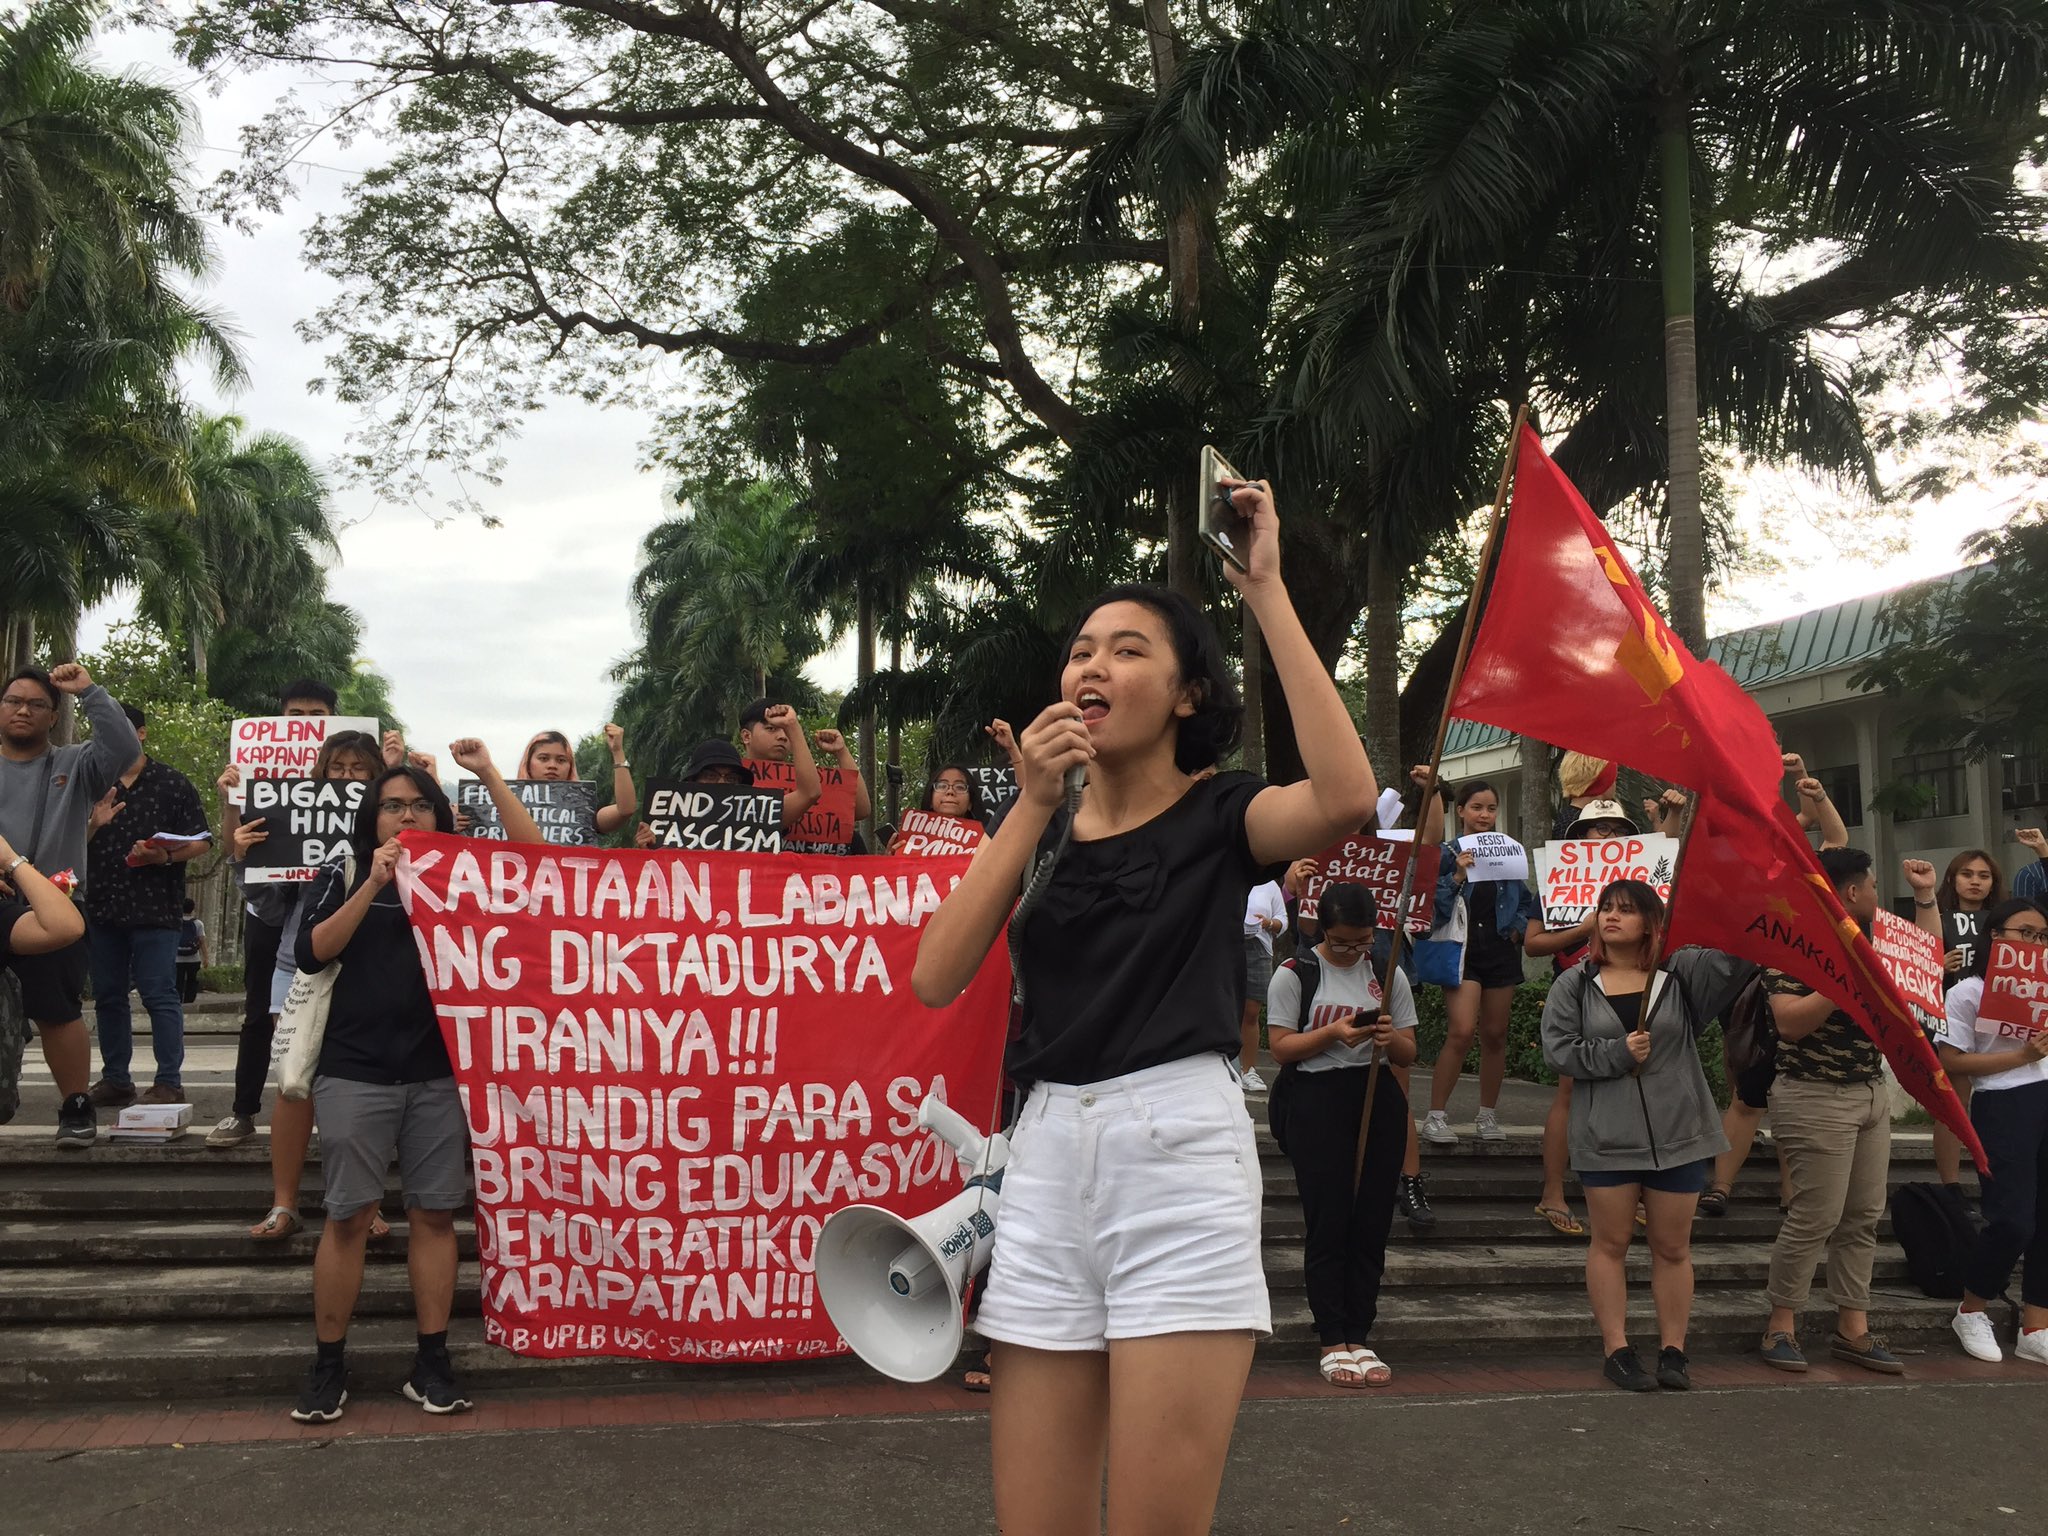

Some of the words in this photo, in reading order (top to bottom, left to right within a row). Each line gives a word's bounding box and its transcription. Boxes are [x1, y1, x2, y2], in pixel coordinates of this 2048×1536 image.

[238, 719, 326, 743] OPLAN
[236, 746, 322, 767] KAPANA
[253, 780, 367, 810] BIGAS
[521, 784, 556, 804] ALL
[649, 790, 714, 818] END
[717, 794, 782, 825] STATE
[290, 808, 357, 835] HIN
[650, 819, 782, 855] FASCISM
[1476, 834, 1506, 846] RESIST
[1342, 841, 1396, 864] end
[1559, 839, 1644, 865] STOP
[1326, 859, 1400, 884] state
[1547, 865, 1650, 884] KILLING
[395, 848, 732, 929] KABATAAN,
[738, 868, 961, 928] LABANA
[551, 929, 894, 996] DIKTADURYA
[436, 1004, 778, 1076] TIRANIYA!!!
[459, 1081, 711, 1151] UMINDIG
[732, 1080, 872, 1151] PARA
[473, 1145, 667, 1212] BRENG
[485, 1315, 530, 1352] PLB
[543, 1324, 606, 1350] UPLB
[614, 1325, 658, 1351] USC
[669, 1334, 784, 1360] SAKBAYAN
